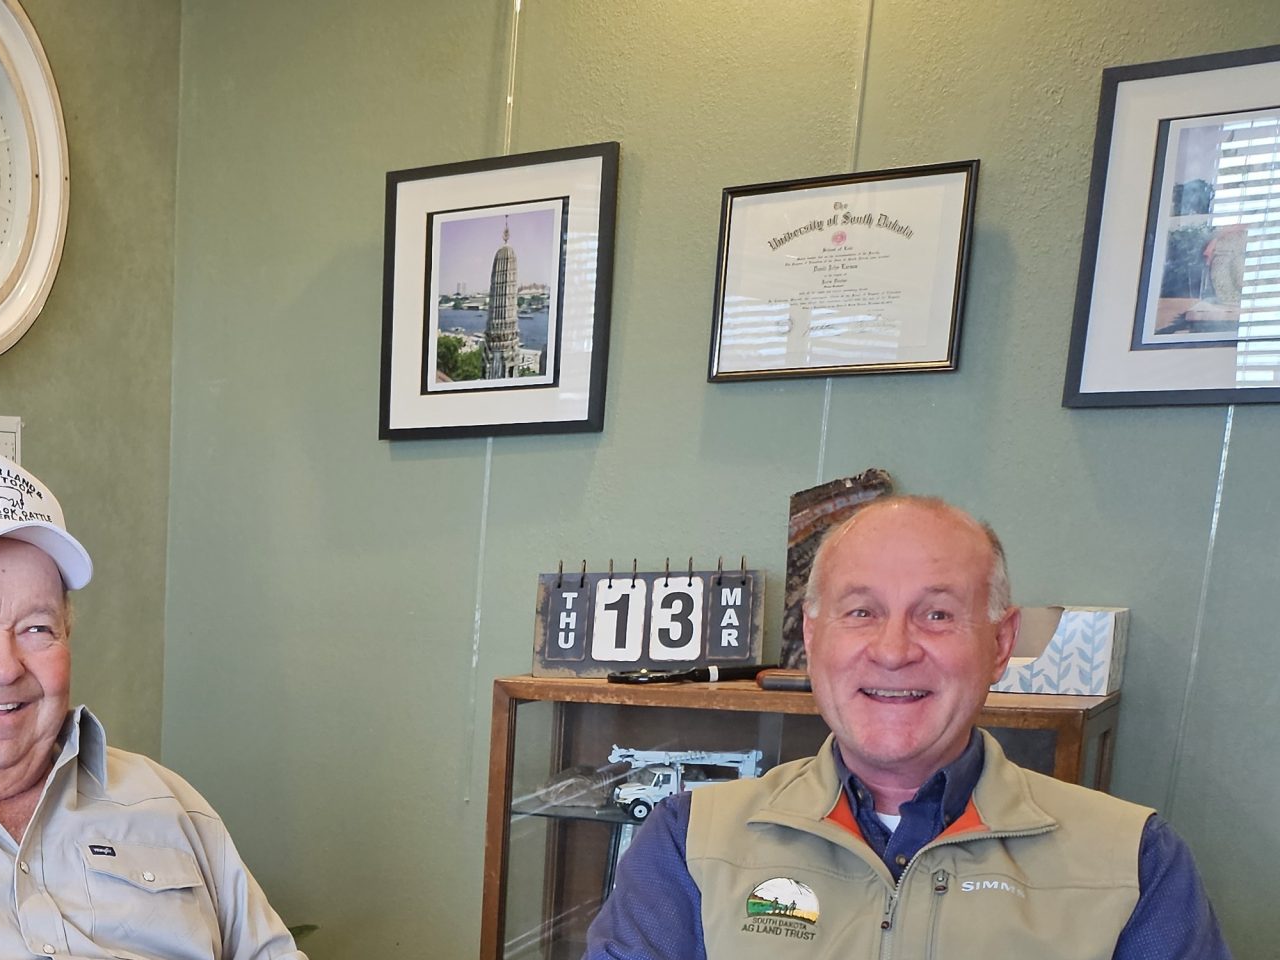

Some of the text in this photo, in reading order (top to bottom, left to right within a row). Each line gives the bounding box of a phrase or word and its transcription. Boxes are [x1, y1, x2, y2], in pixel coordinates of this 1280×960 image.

[768, 212, 916, 251] University of South Dakota
[7, 470, 36, 493] LAND
[36, 491, 43, 500] &
[22, 510, 53, 523] CATTLE
[557, 592, 578, 649] THU
[720, 587, 742, 647] MAR
[741, 924, 816, 940] AG LAND TRUST
[753, 918, 807, 930] SOUTH DAKOTA
